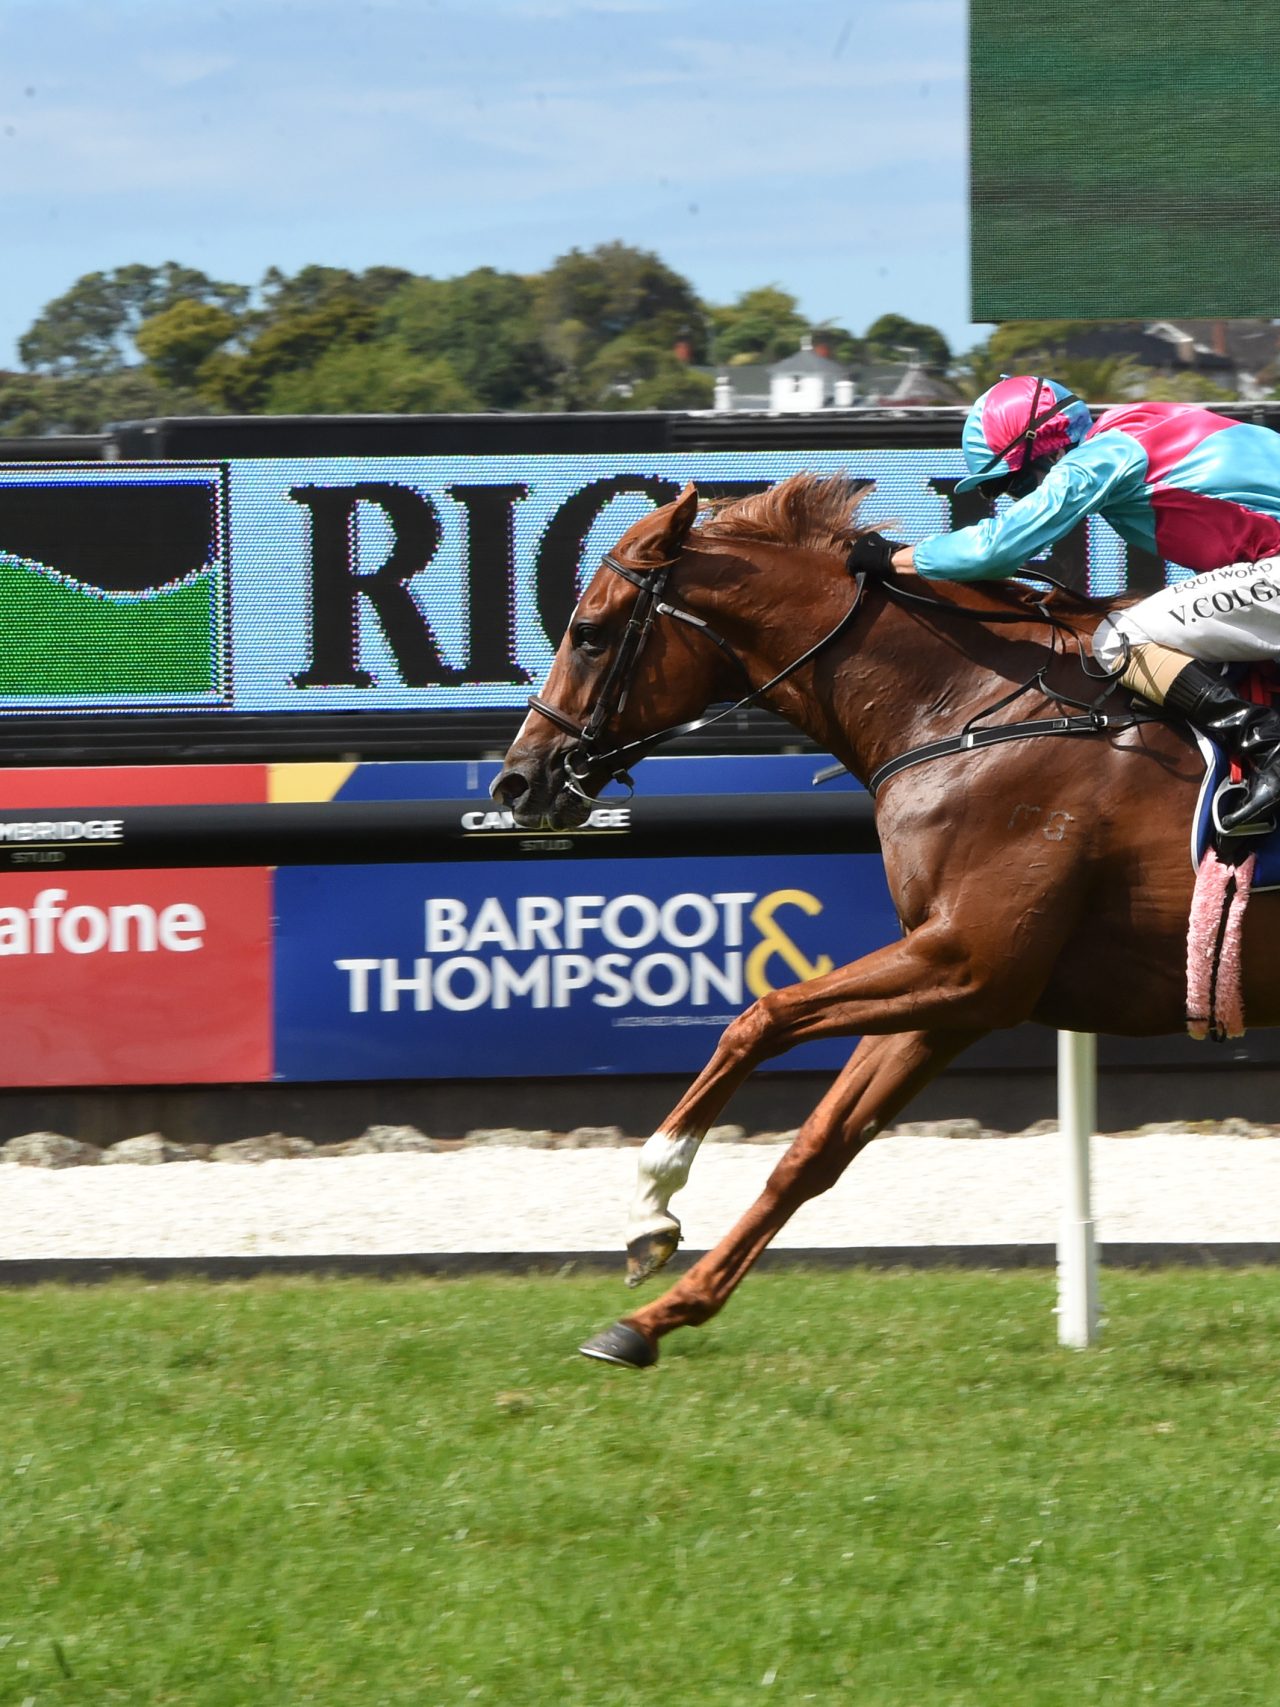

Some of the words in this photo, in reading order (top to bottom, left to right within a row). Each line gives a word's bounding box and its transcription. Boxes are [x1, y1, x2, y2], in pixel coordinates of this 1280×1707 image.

[286, 474, 876, 690] RIC
[425, 892, 757, 953] BARFOOT
[335, 951, 744, 1013] THOMPSON
